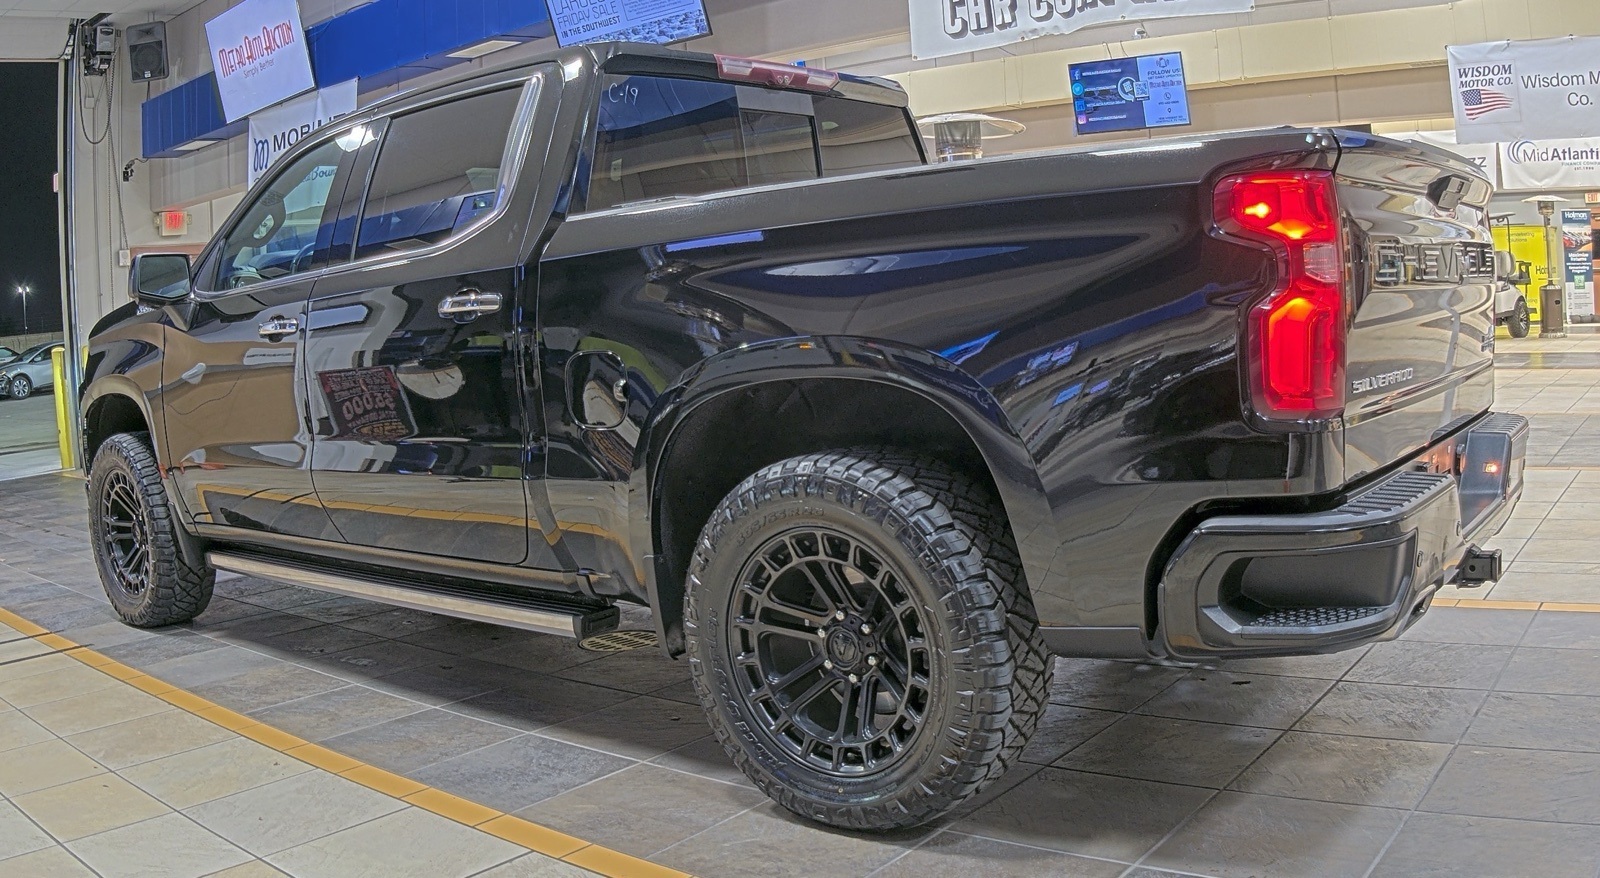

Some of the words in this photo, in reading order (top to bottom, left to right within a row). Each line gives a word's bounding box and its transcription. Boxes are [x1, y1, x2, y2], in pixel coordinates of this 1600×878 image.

[557, 9, 590, 29] FRIDAY
[592, 1, 618, 19] SALE
[561, 30, 568, 38] IN
[569, 27, 581, 36] THE
[581, 15, 621, 33] SOUTHWEST
[1457, 64, 1512, 79] WISDOM
[1459, 79, 1494, 89] MOTOR
[1497, 77, 1514, 86] CO.
[1521, 72, 1585, 89] Wisdom
[1567, 92, 1593, 106] Co.
[1352, 368, 1413, 394] SILVERADO
